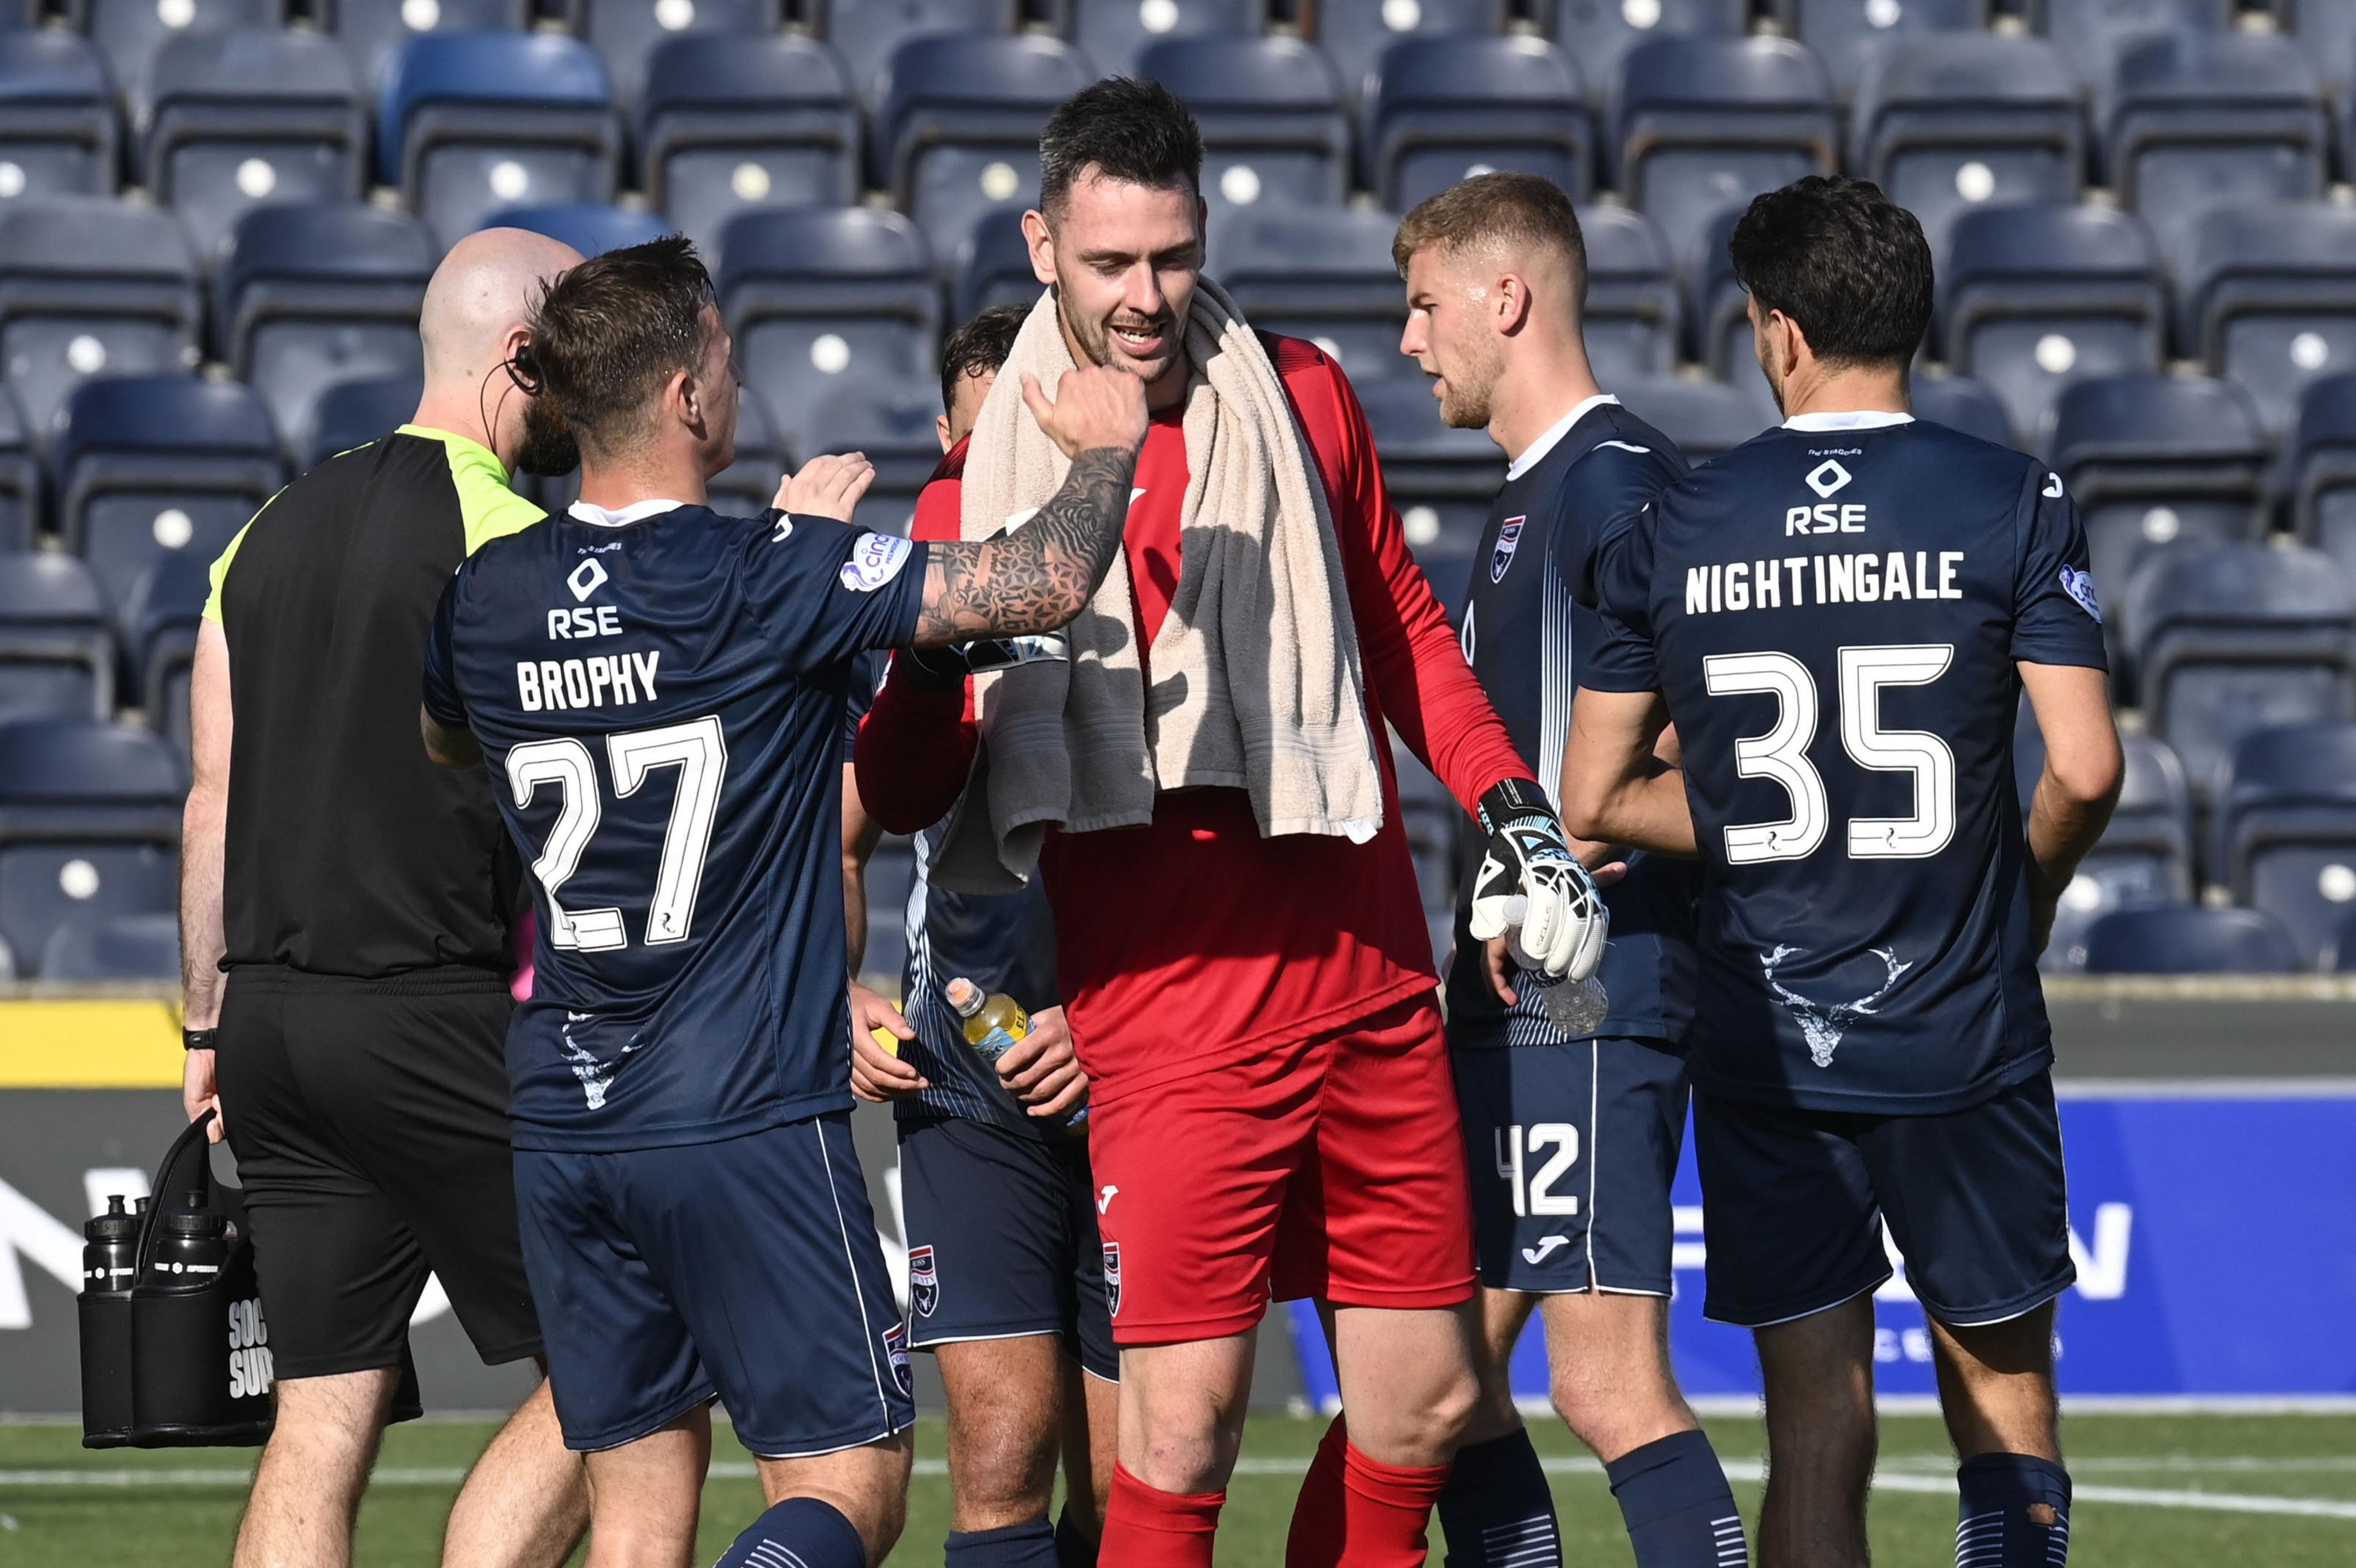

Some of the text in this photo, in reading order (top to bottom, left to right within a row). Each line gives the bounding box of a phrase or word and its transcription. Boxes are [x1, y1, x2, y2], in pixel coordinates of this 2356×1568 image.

[1785, 503, 1866, 536] RSE
[1685, 551, 1964, 615] NIGHTINGALE
[548, 605, 623, 640] RSE
[516, 650, 660, 712] BROPHY
[1702, 644, 1956, 865] 35
[504, 714, 728, 953] 27
[1495, 1123, 1579, 1217] 42
[229, 1297, 268, 1350] SOC
[229, 1346, 274, 1399] SUP
